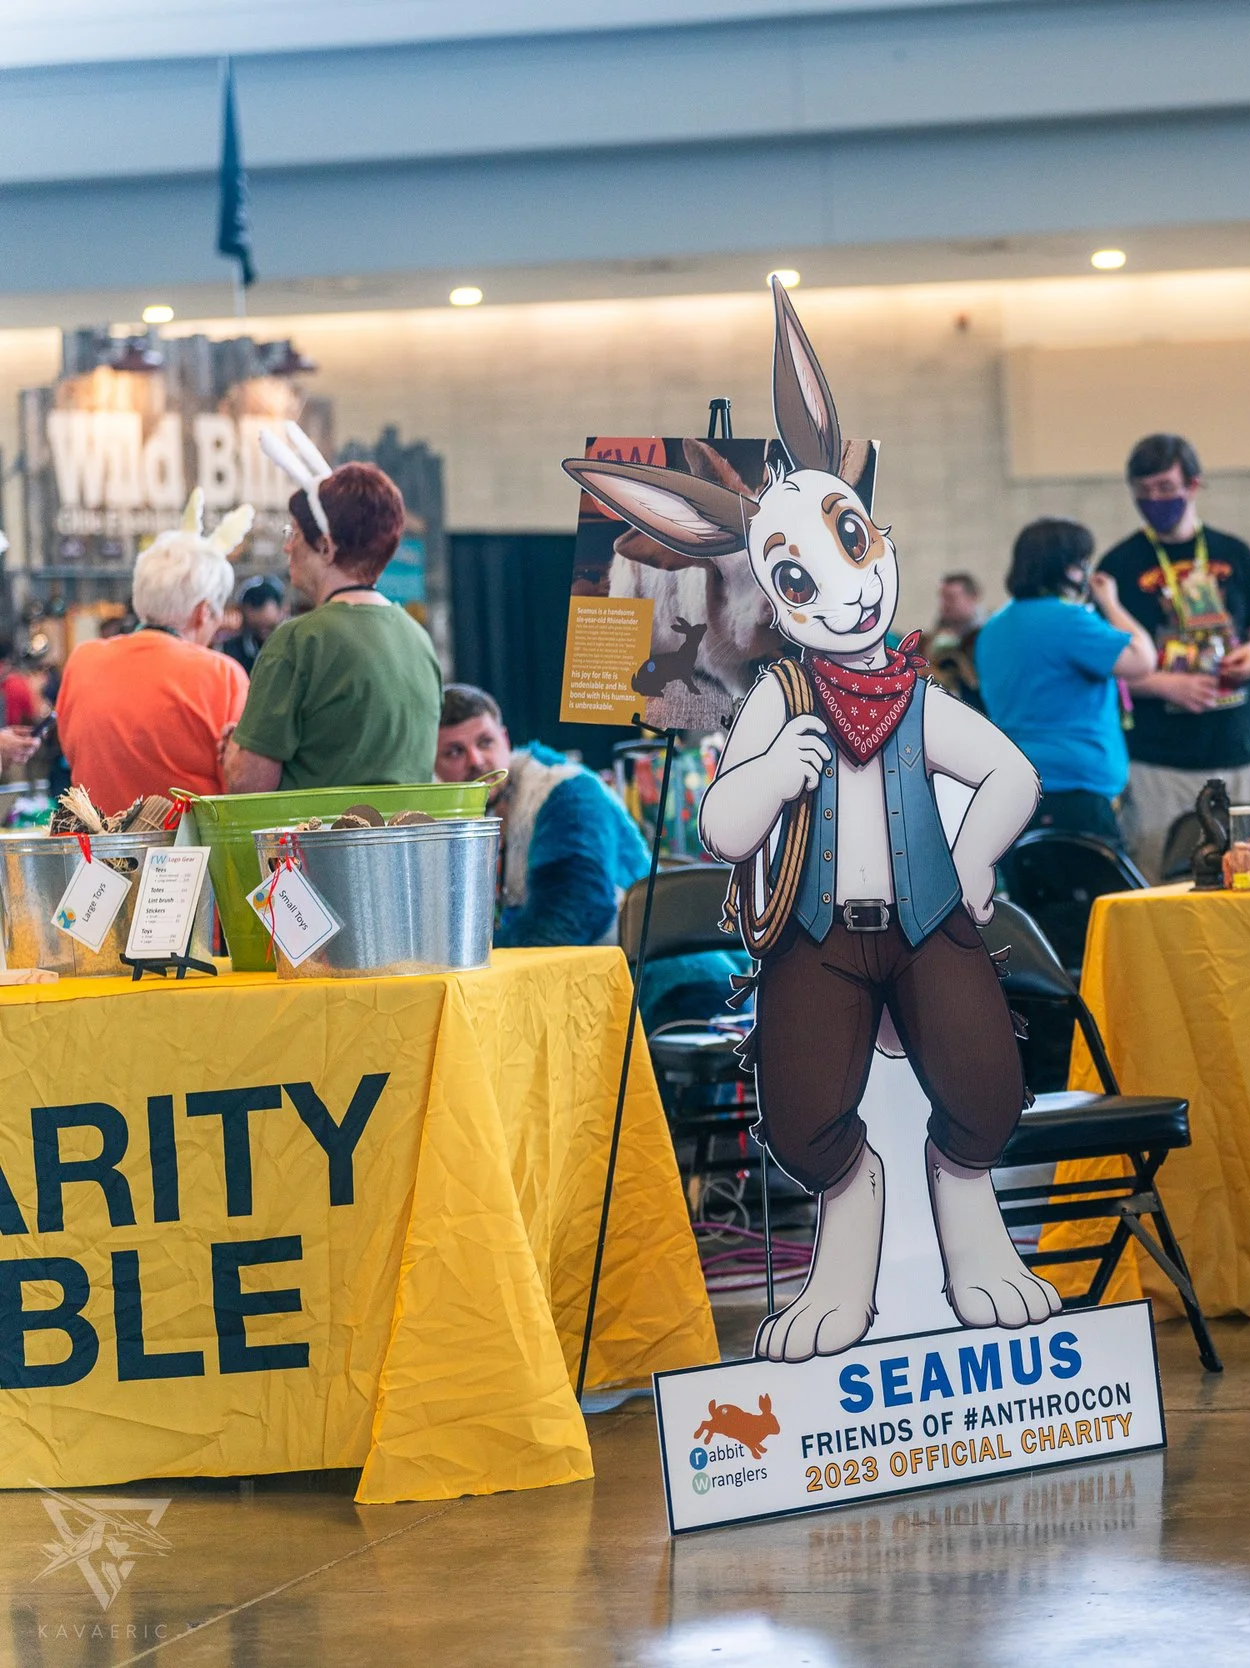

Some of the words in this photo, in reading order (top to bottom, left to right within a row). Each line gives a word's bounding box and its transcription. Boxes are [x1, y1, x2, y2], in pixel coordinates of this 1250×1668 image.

[577, 608, 597, 616] Seamus
[607, 608, 635, 617] handsome
[570, 681, 604, 690] undeniable
[605, 682, 617, 691] and
[618, 683, 627, 691] his
[571, 670, 581, 678] his
[581, 671, 591, 680] joy
[592, 671, 601, 679] for
[601, 671, 612, 679] life
[575, 701, 615, 711] unbreakable.
[586, 692, 600, 700] with
[601, 692, 610, 700] his
[611, 693, 636, 702] humans
[82, 900, 97, 922] Large
[93, 882, 106, 899] Toys
[279, 889, 297, 912] Small
[294, 910, 309, 931] Toys
[0, 1072, 391, 1236] RITY
[839, 1331, 1083, 1413] SEAMUS
[801, 1417, 914, 1459] FRIENDS
[922, 1410, 955, 1438] OF
[964, 1382, 1132, 1431] #ANTHROCON
[690, 1443, 745, 1469] rabbit
[805, 1456, 879, 1493] 2023
[890, 1433, 1012, 1477] OFFICIAL
[1020, 1411, 1134, 1455] CHARITY
[693, 1467, 768, 1493] wranglers
